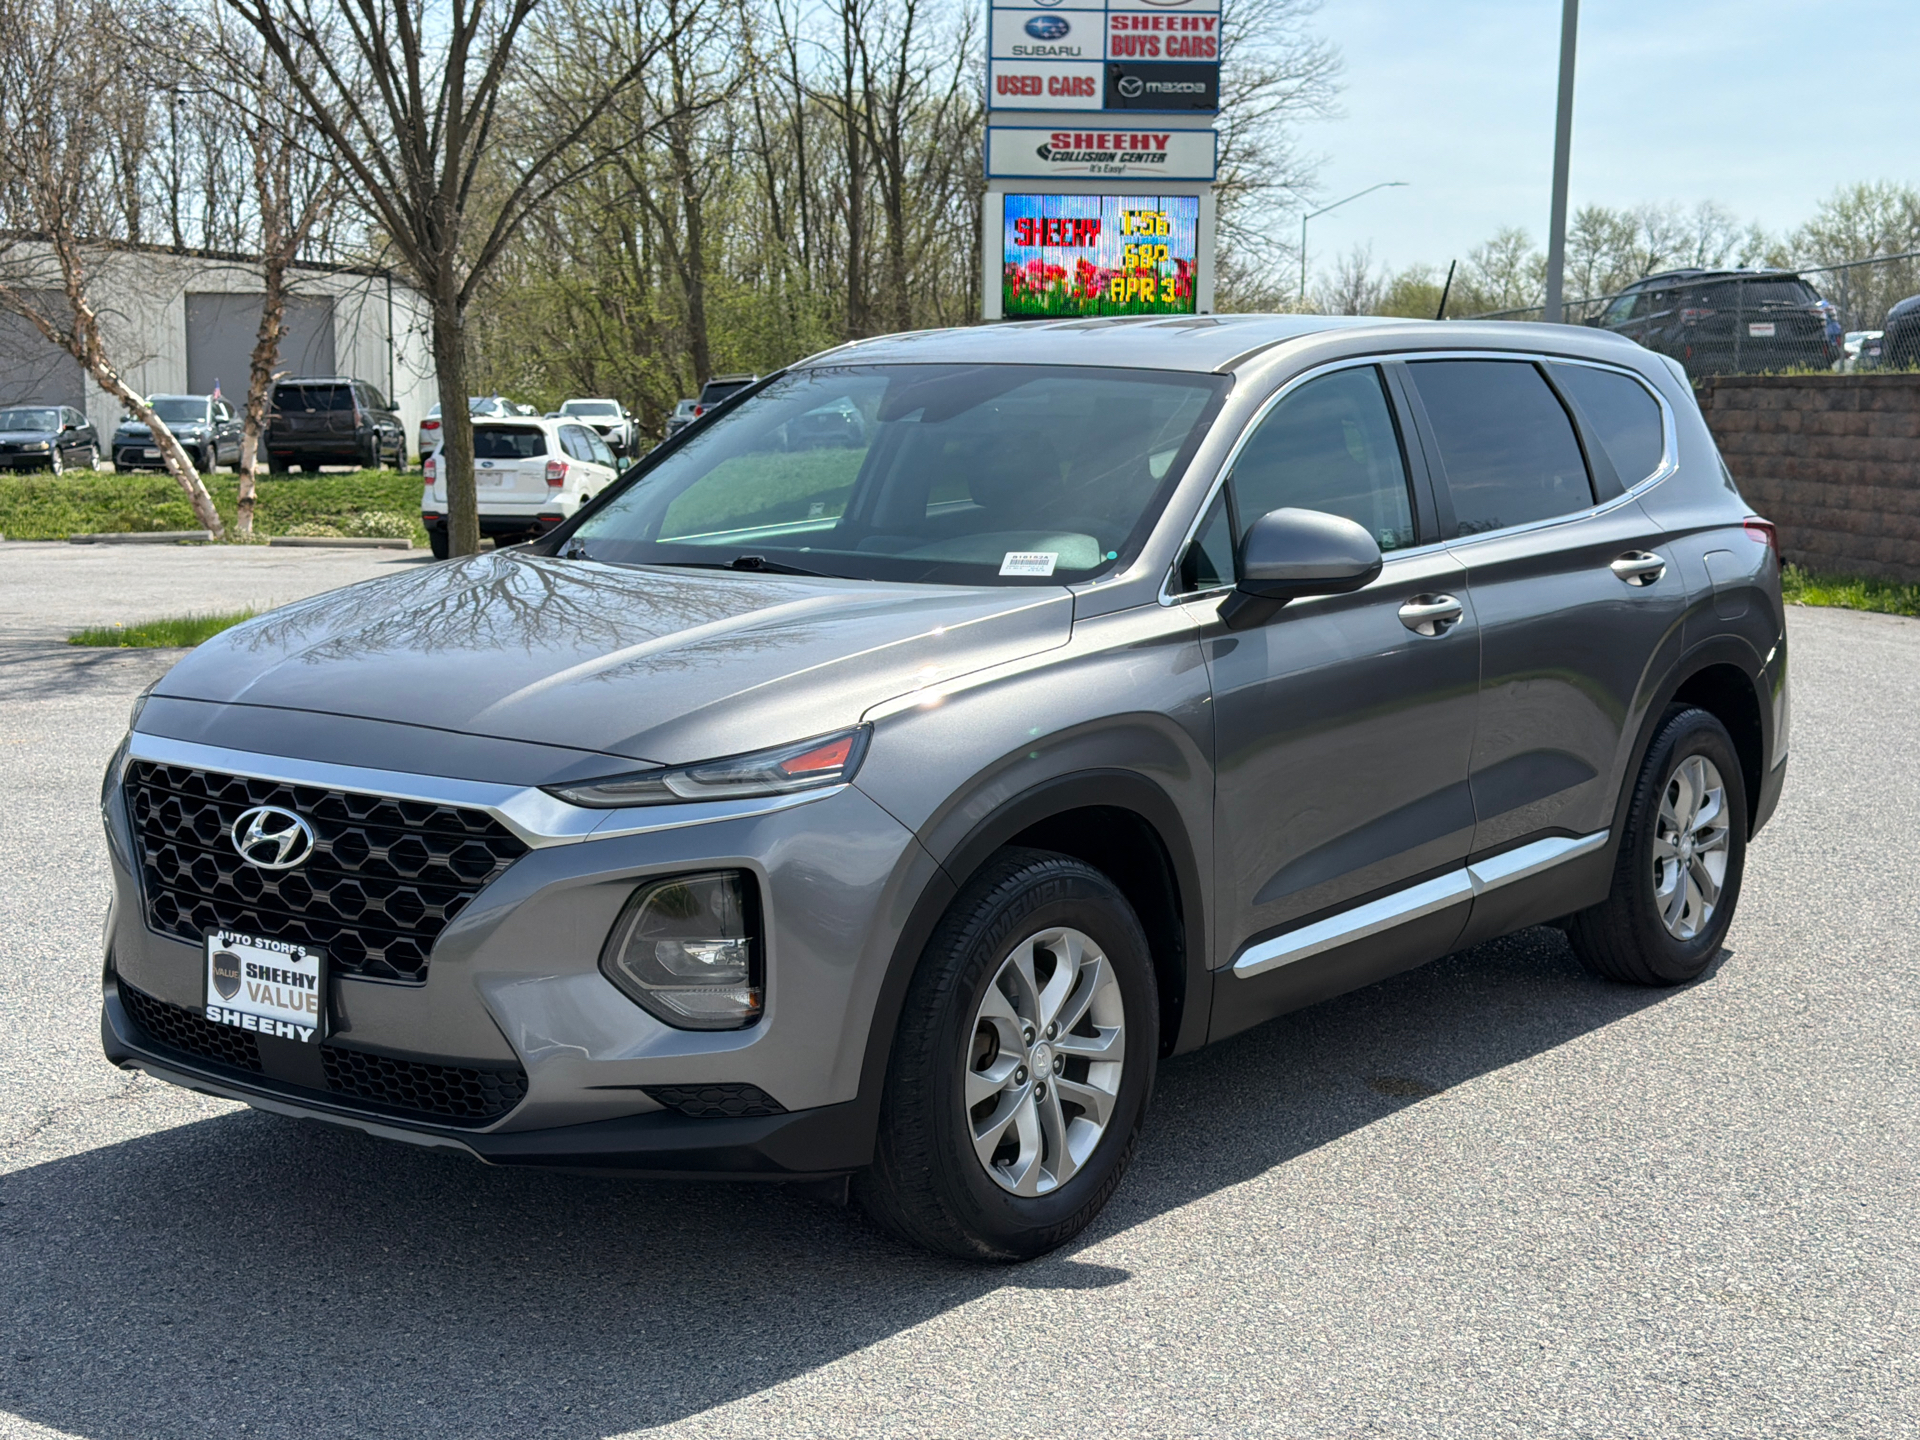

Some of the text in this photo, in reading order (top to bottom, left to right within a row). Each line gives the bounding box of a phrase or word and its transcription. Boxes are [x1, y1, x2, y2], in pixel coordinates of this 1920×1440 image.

[1111, 15, 1217, 31] SHEEHY
[1012, 45, 1081, 56] SUBARU
[1111, 35, 1216, 57] BUYS CARS
[997, 75, 1095, 96] USED CARS
[1146, 81, 1205, 93] mazda
[1051, 133, 1170, 150] SHEEHY
[1051, 151, 1167, 163] COLLISION CENTER
[1017, 217, 1101, 247] SHEEHY
[1110, 277, 1175, 303] APR 3
[216, 930, 251, 945] AUTO
[214, 967, 239, 979] VALUE
[246, 962, 317, 990] SHEEHY
[247, 981, 318, 1014] VALUE
[206, 1006, 314, 1043] SHEEHY
